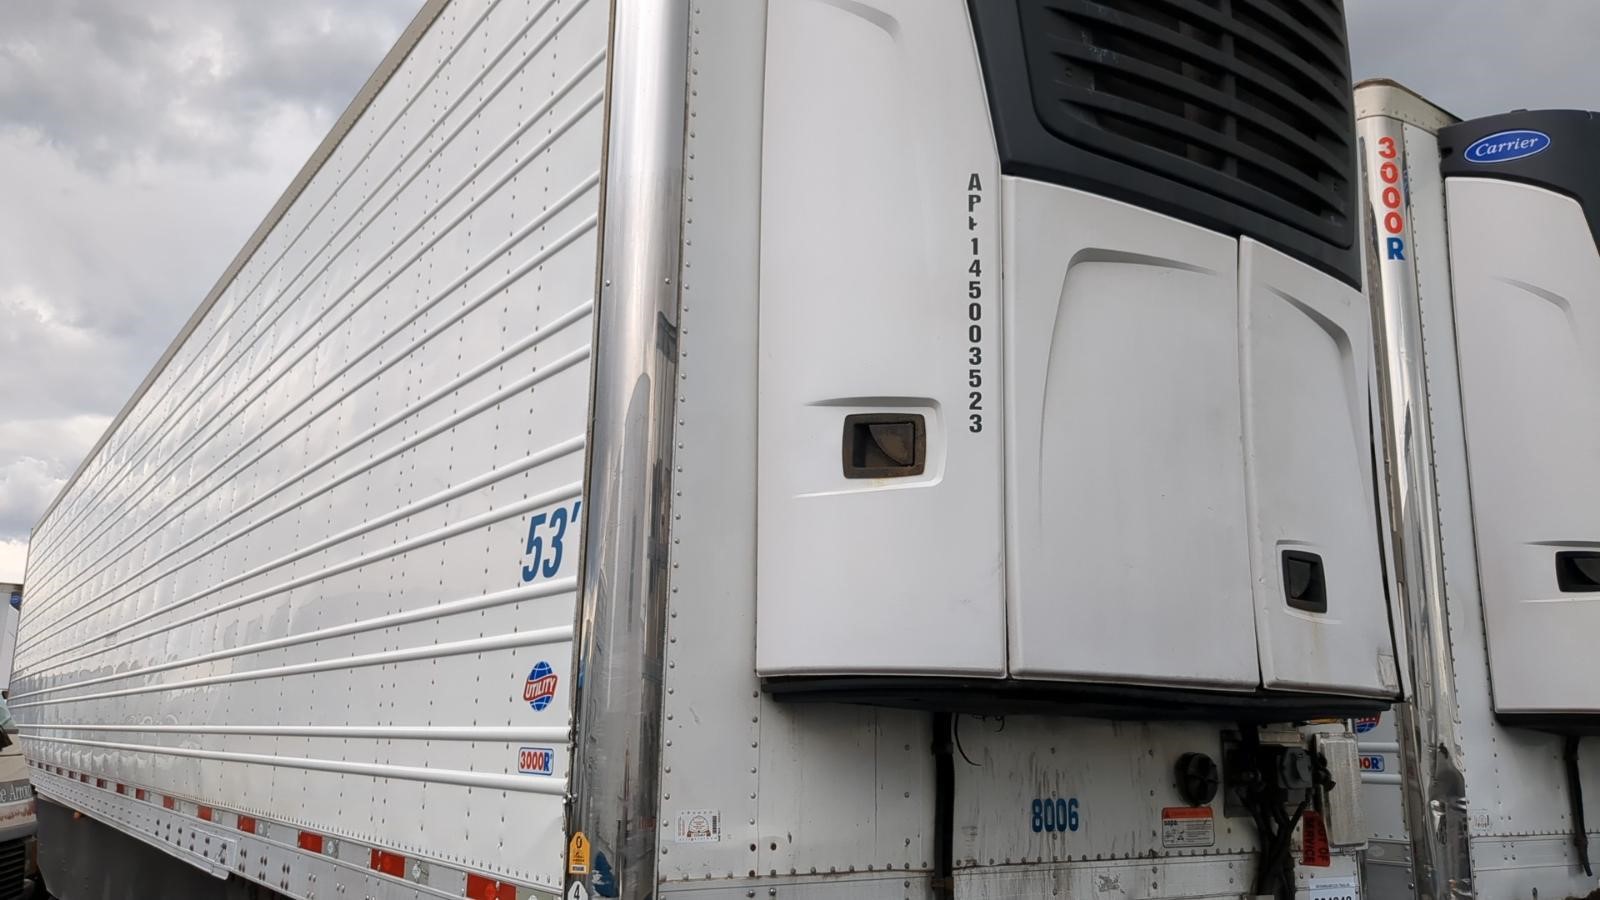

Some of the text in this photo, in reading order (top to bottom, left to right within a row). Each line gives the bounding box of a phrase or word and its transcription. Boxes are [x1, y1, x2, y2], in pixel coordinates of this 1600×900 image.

[1475, 137, 1539, 157] Carrier
[1379, 137, 1405, 260] 3000R
[525, 678, 556, 698] UTILITY
[520, 751, 551, 771] 3000R
[1032, 798, 1079, 832] 8006
